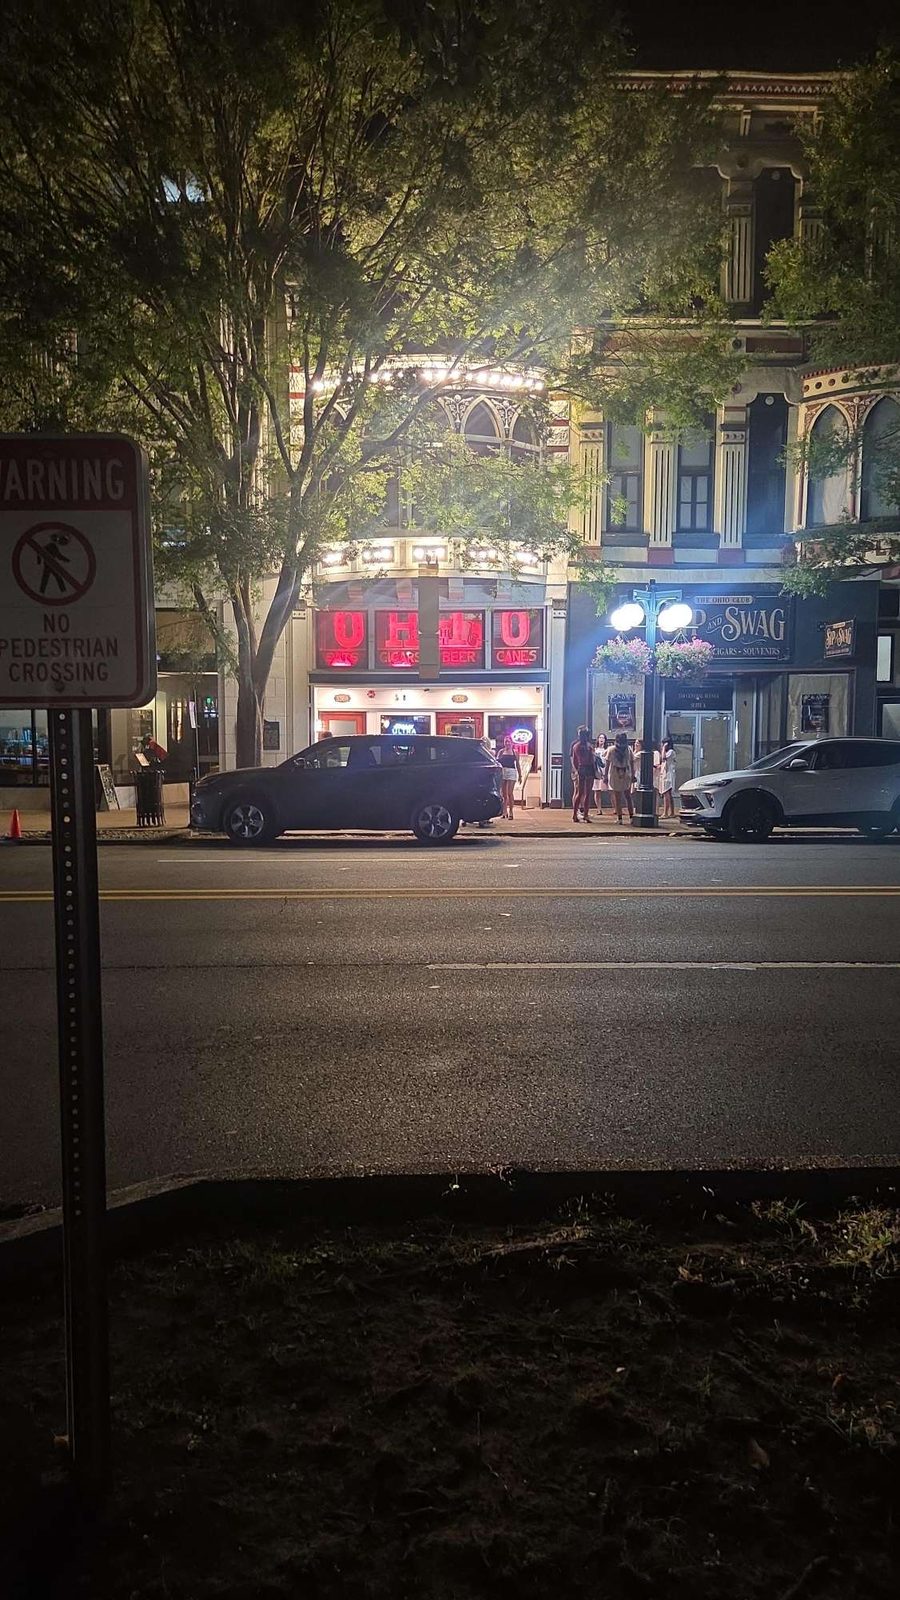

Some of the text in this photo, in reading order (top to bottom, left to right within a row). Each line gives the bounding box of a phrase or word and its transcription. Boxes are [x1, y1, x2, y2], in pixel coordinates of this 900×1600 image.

[0, 458, 125, 501] ARNING
[43, 613, 70, 633] NO
[707, 616, 723, 630] AND
[721, 606, 785, 641] SWAG
[0, 637, 119, 658] PEDESTRIAN
[442, 651, 476, 663] BEER
[496, 650, 538, 662] CANES
[743, 648, 780, 656] SOUVENIRS
[9, 662, 109, 682] CROSSING
